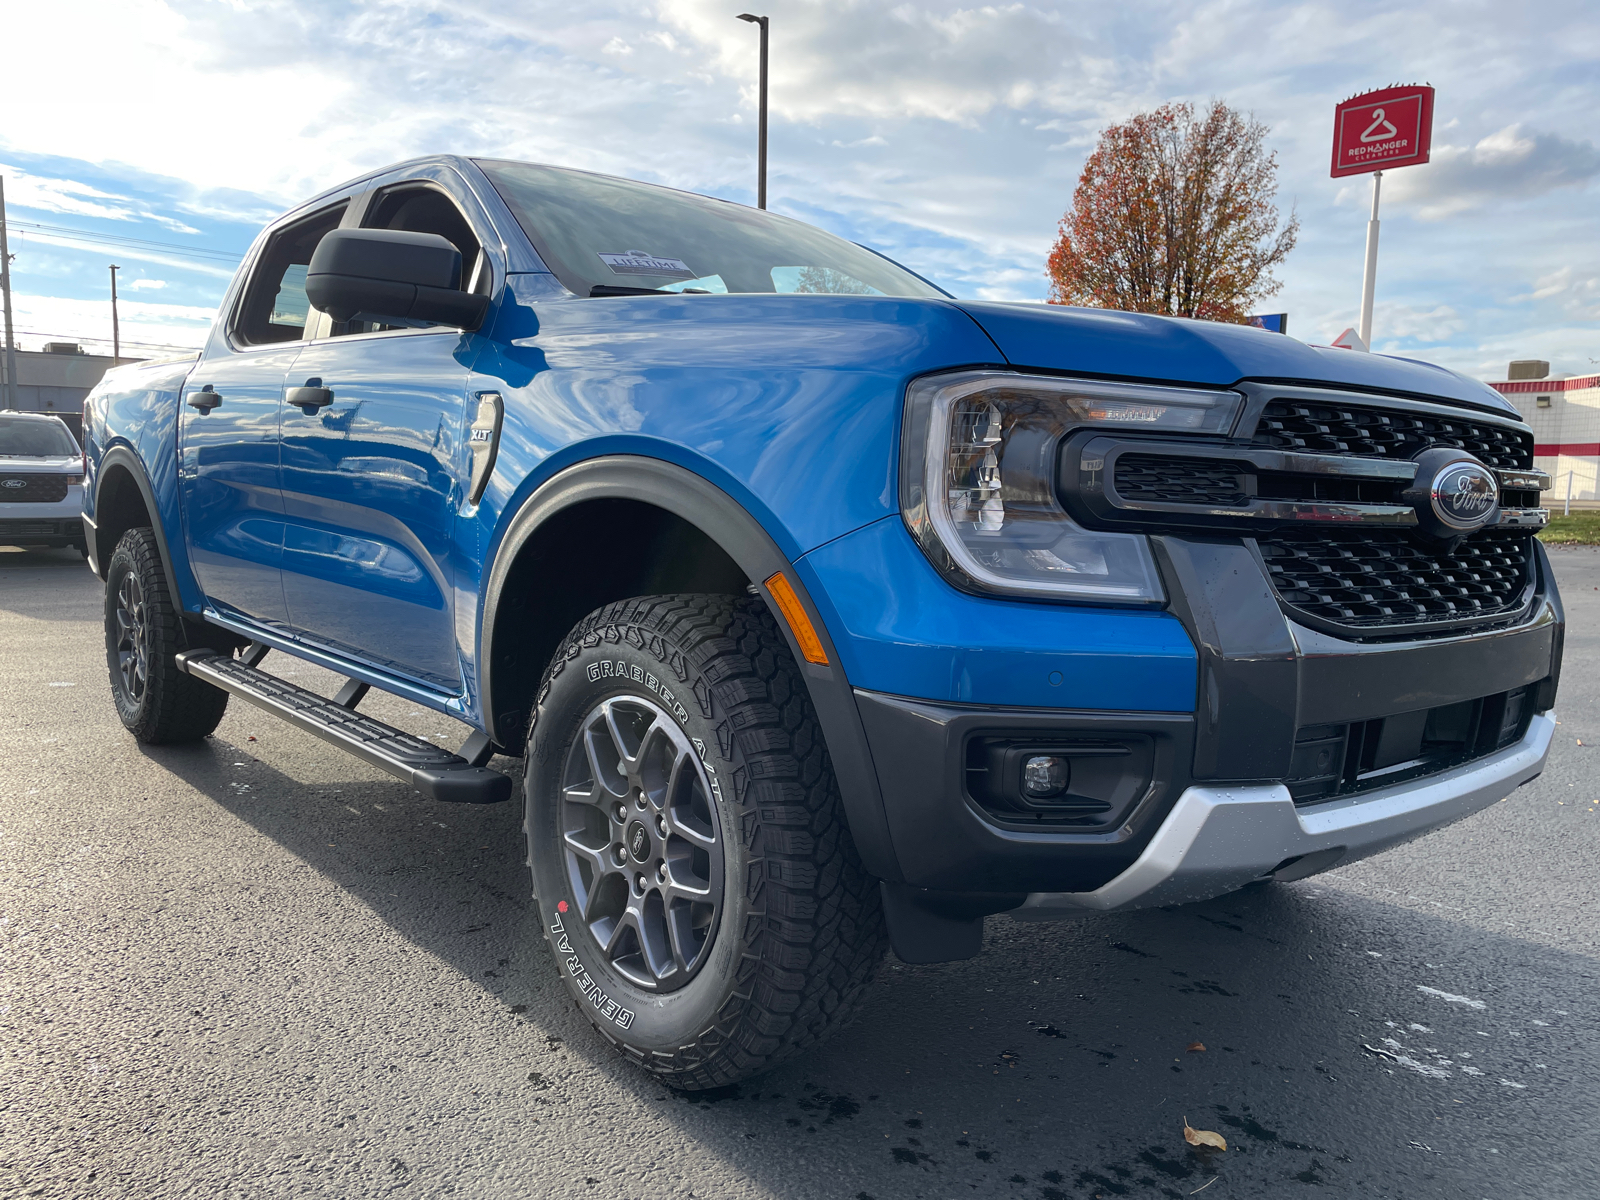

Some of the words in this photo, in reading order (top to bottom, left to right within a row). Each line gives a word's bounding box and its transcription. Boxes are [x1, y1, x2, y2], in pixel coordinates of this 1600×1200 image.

[1348, 147, 1366, 157] RED
[1367, 139, 1408, 153] HANGER
[1355, 149, 1399, 161] CLEANERS
[612, 258, 680, 270] LIFETIME
[471, 429, 492, 441] XLT
[1453, 475, 1488, 510] Ford
[586, 660, 689, 725] GRABBER
[692, 737, 723, 802] A/T
[550, 912, 635, 1030] GENERAL
